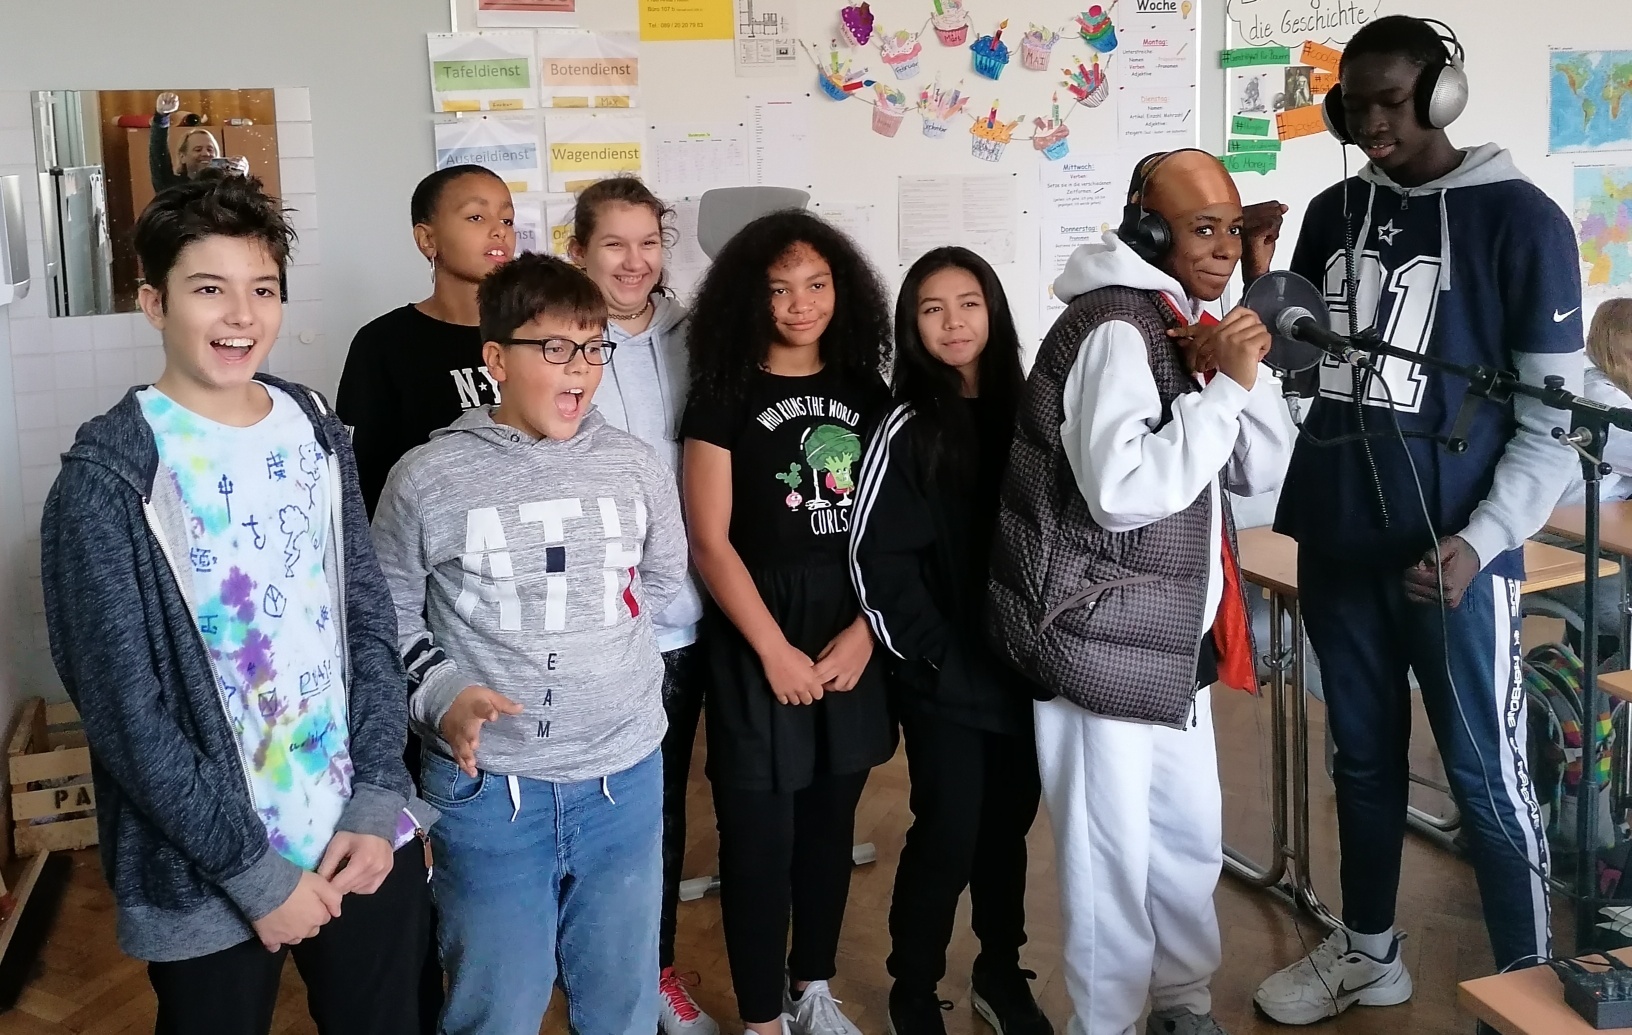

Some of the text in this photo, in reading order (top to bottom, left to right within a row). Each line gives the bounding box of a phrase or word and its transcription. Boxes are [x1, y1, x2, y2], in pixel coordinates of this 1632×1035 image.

[1136, 0, 1177, 11] Woche
[1249, 1, 1369, 40] die Geschichte
[1025, 52, 1045, 66] MAI
[442, 64, 521, 79] Tafeldienst
[550, 63, 631, 76] Botendienst
[446, 149, 530, 166] Austeildienst
[552, 147, 639, 163] Wagendienst
[756, 395, 860, 432] WHO RUNS THE WORLD
[810, 508, 849, 536] CURLS
[54, 786, 92, 809] PA
